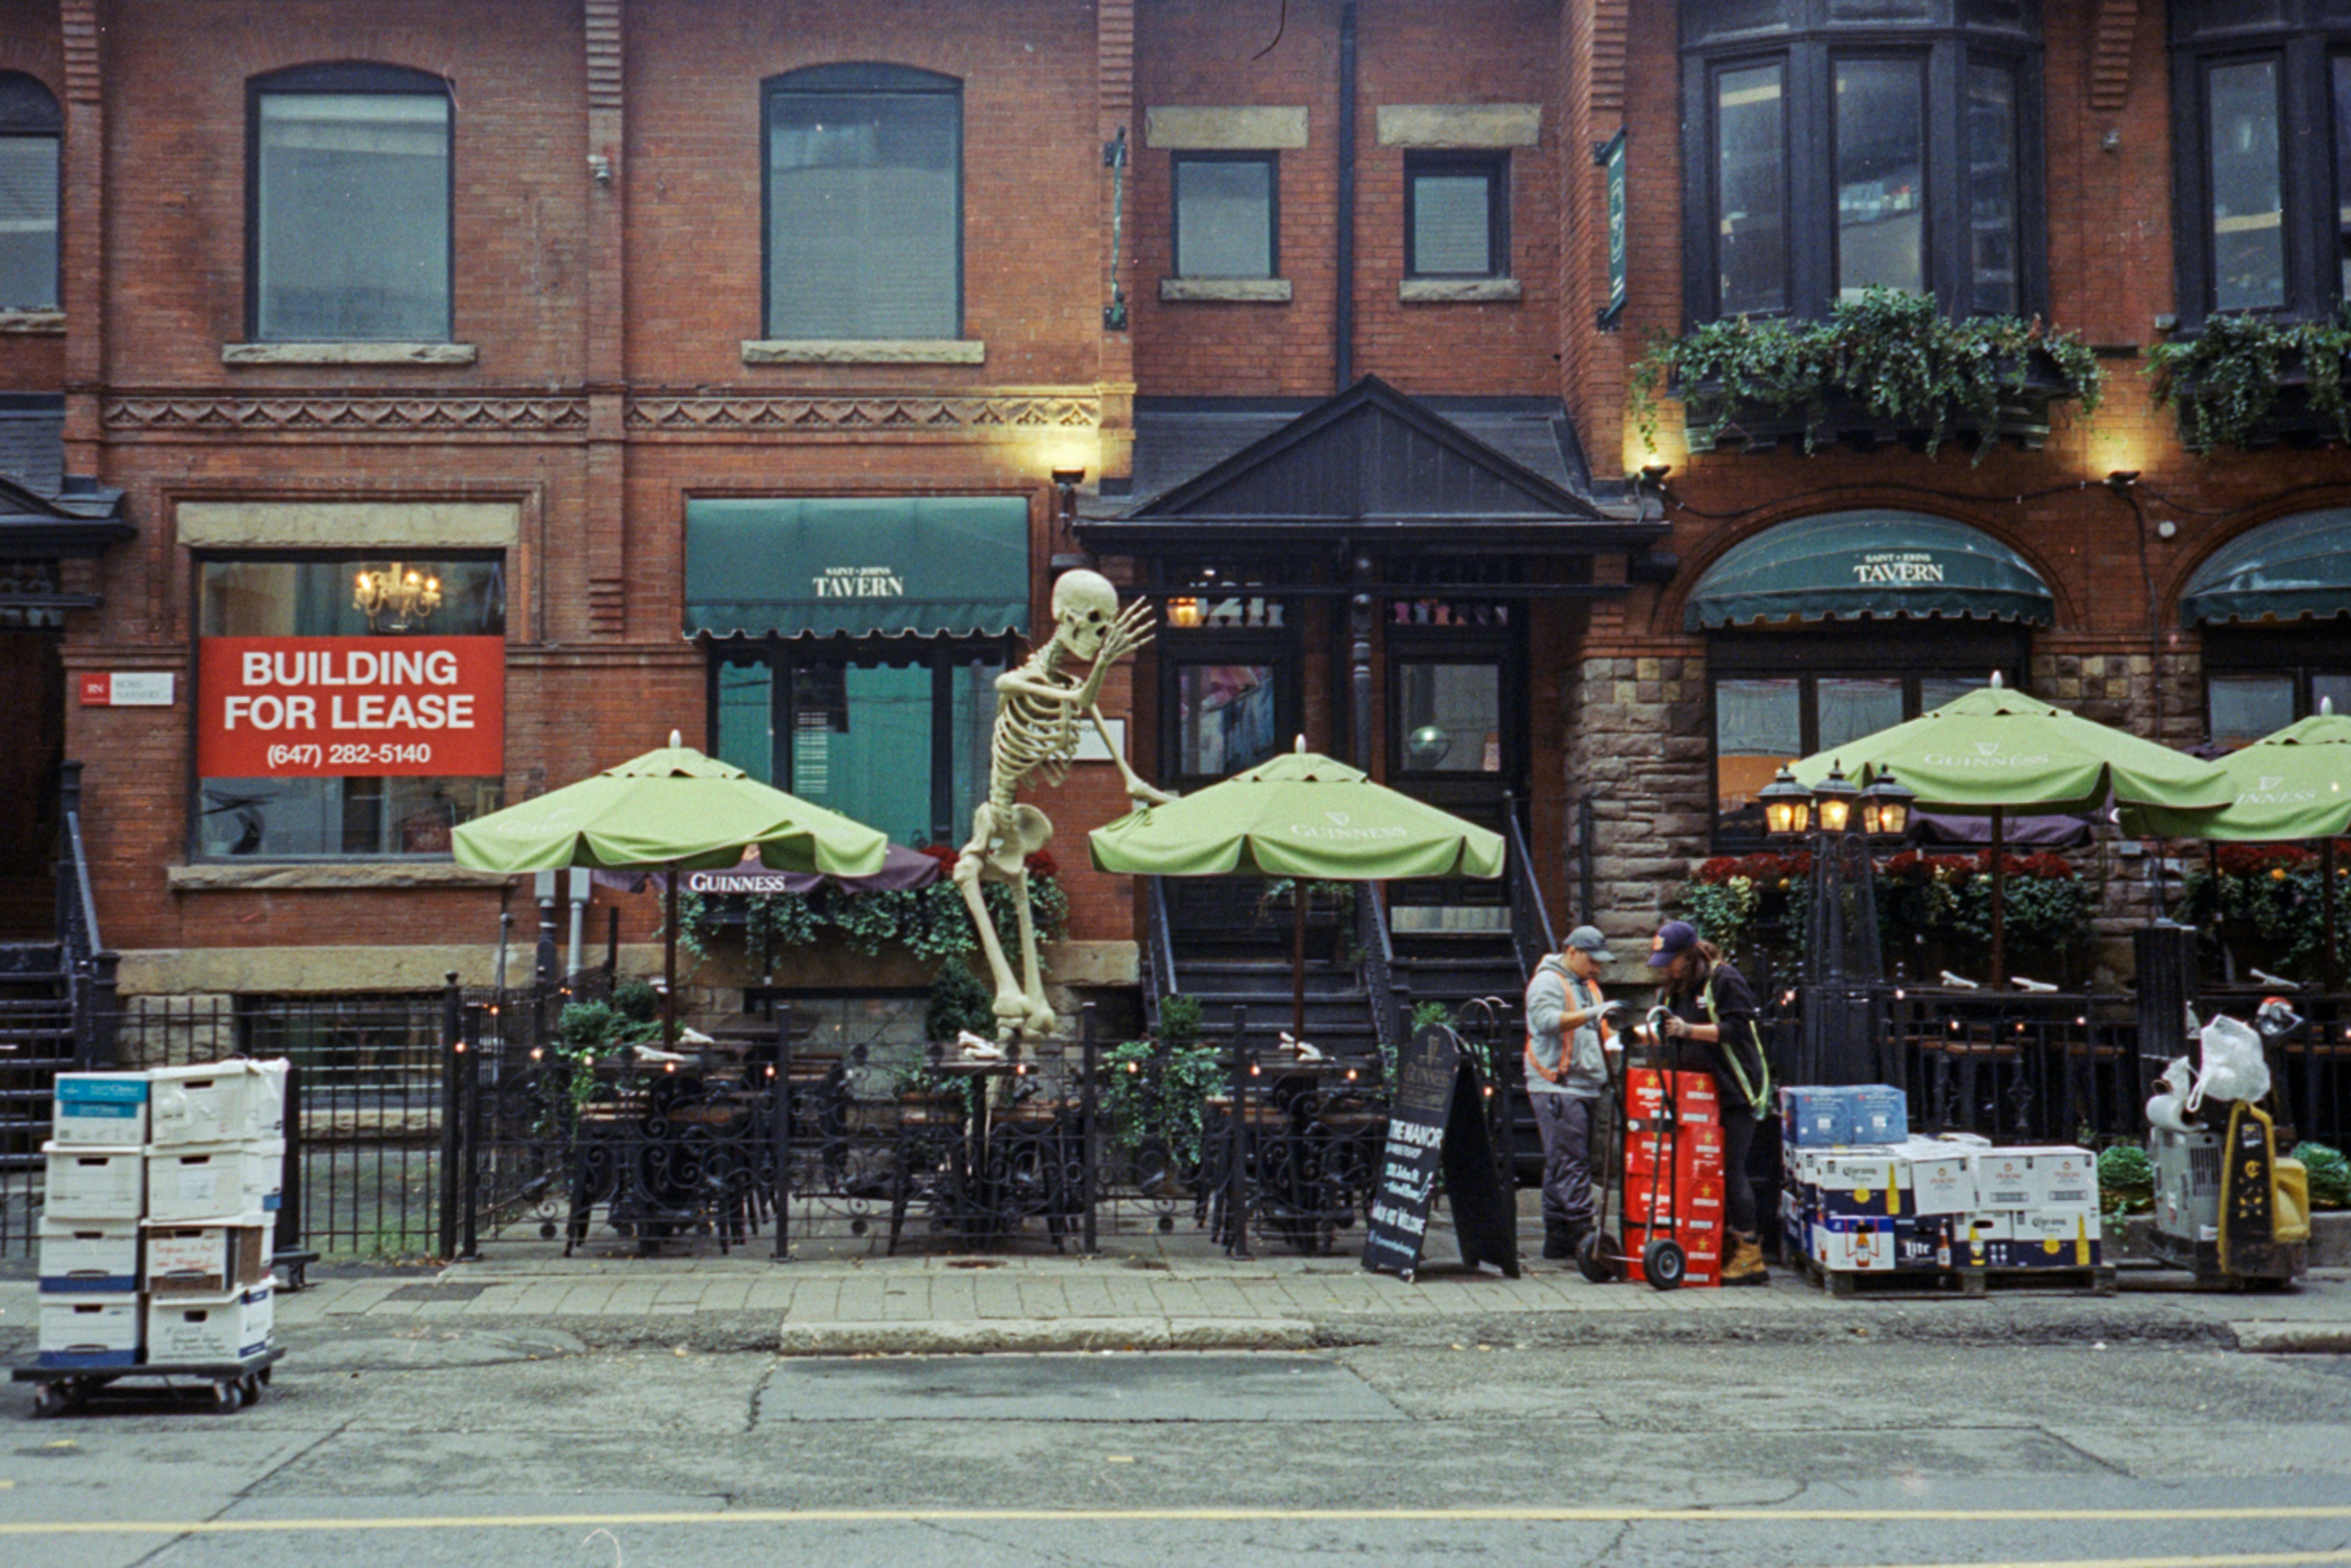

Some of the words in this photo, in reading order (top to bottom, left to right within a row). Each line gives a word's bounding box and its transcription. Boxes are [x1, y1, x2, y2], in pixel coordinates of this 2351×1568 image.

[1865, 554, 1894, 563] SAINT
[825, 567, 855, 576] SAINT
[860, 566, 891, 576] JOHNS
[1853, 563, 1945, 583] TAVERN
[812, 576, 904, 598] TAVERN
[243, 650, 457, 686] BUILDING
[224, 695, 316, 730] FOR
[331, 694, 475, 729] LEASE
[267, 743, 323, 768] (647)
[329, 743, 432, 764] 282-5140
[1923, 751, 2050, 768] GUINNESS
[1291, 823, 1407, 839] GUINNESS
[690, 873, 785, 892] GUINNESS
[1905, 1241, 1931, 1258] Lite
